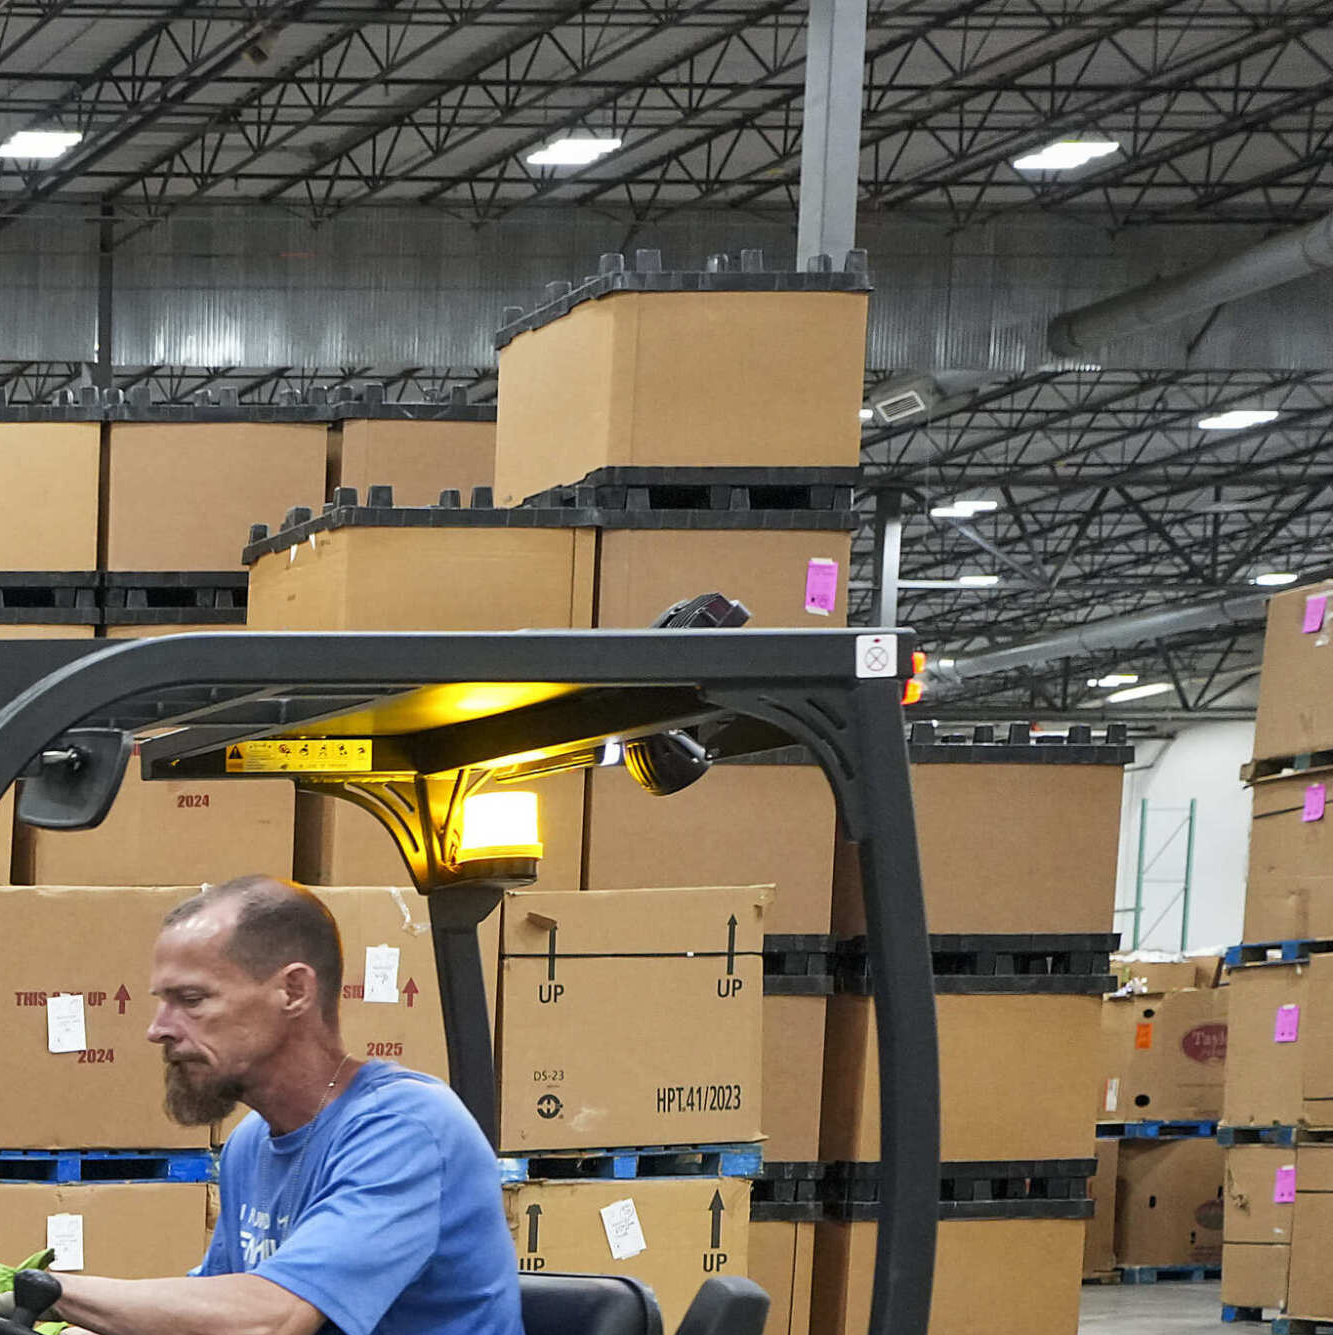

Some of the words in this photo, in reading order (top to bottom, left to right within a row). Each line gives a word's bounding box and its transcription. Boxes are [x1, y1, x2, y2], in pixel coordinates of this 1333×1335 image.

[177, 794, 210, 808] 2024
[538, 984, 565, 1003] UP
[717, 978, 743, 998] UP
[14, 991, 47, 1007] THIS
[87, 991, 107, 1007] UP
[77, 1048, 115, 1064] 2024
[366, 1042, 403, 1057] 2025
[533, 1070, 565, 1081] DS-23
[703, 1253, 727, 1273] UP
